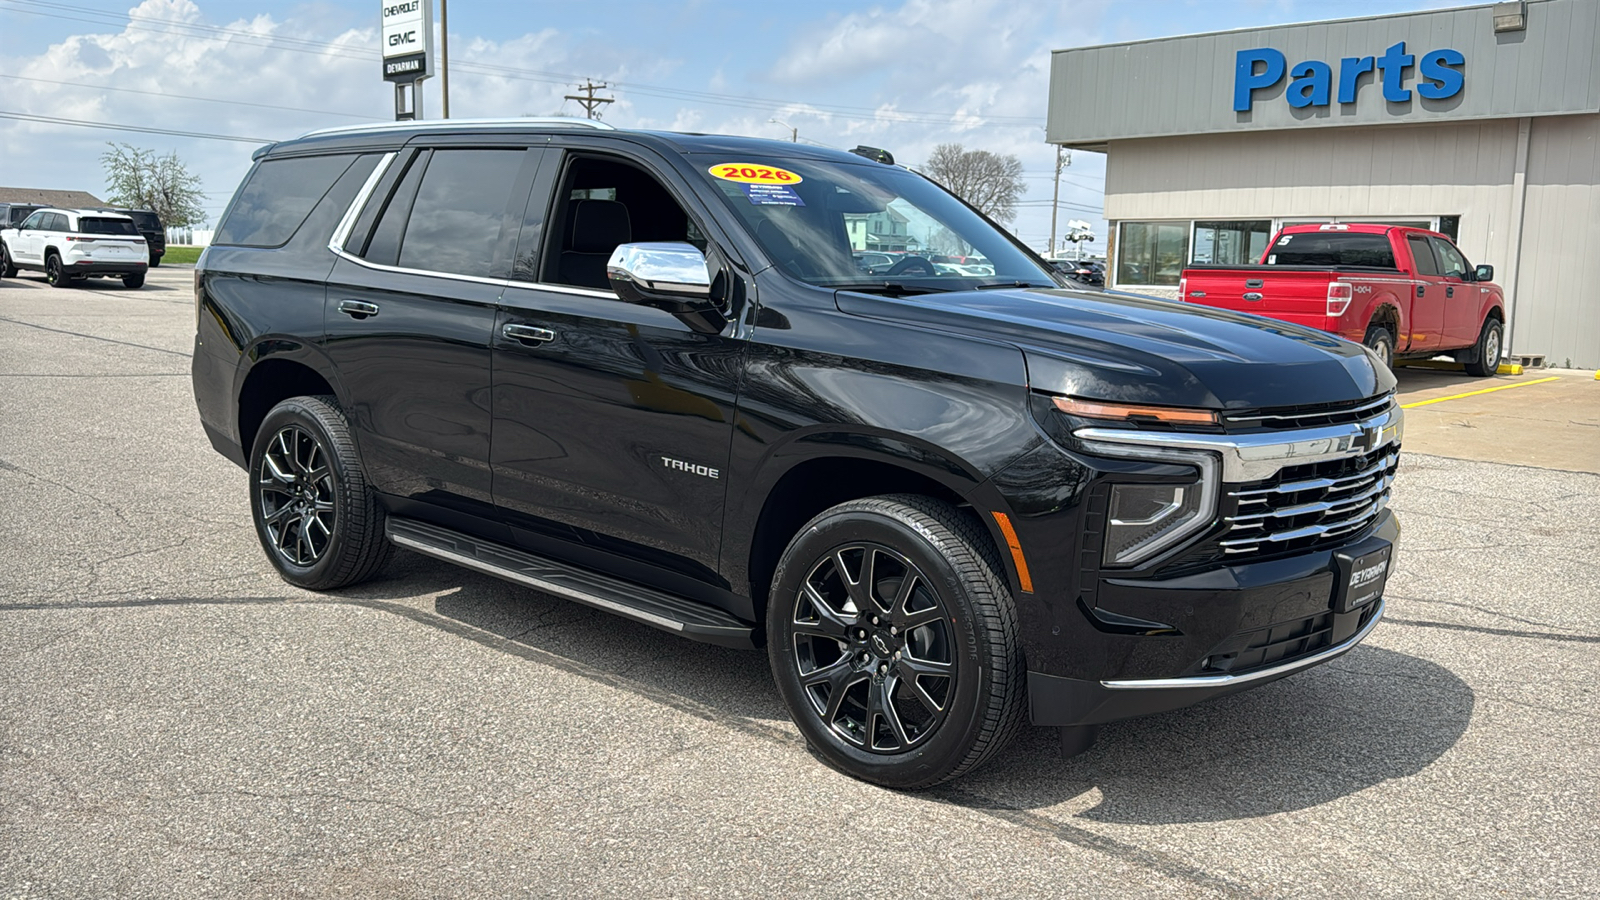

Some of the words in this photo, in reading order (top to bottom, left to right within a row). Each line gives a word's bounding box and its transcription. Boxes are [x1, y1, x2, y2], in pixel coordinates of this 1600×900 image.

[384, 1, 419, 18] CHEVROLET
[388, 30, 416, 46] GMC
[387, 60, 419, 74] DEYARMAN
[1233, 41, 1465, 112] Parts
[722, 167, 792, 181] 2026
[661, 456, 719, 479] TAHOE
[1349, 559, 1388, 587] DEYARMAN
